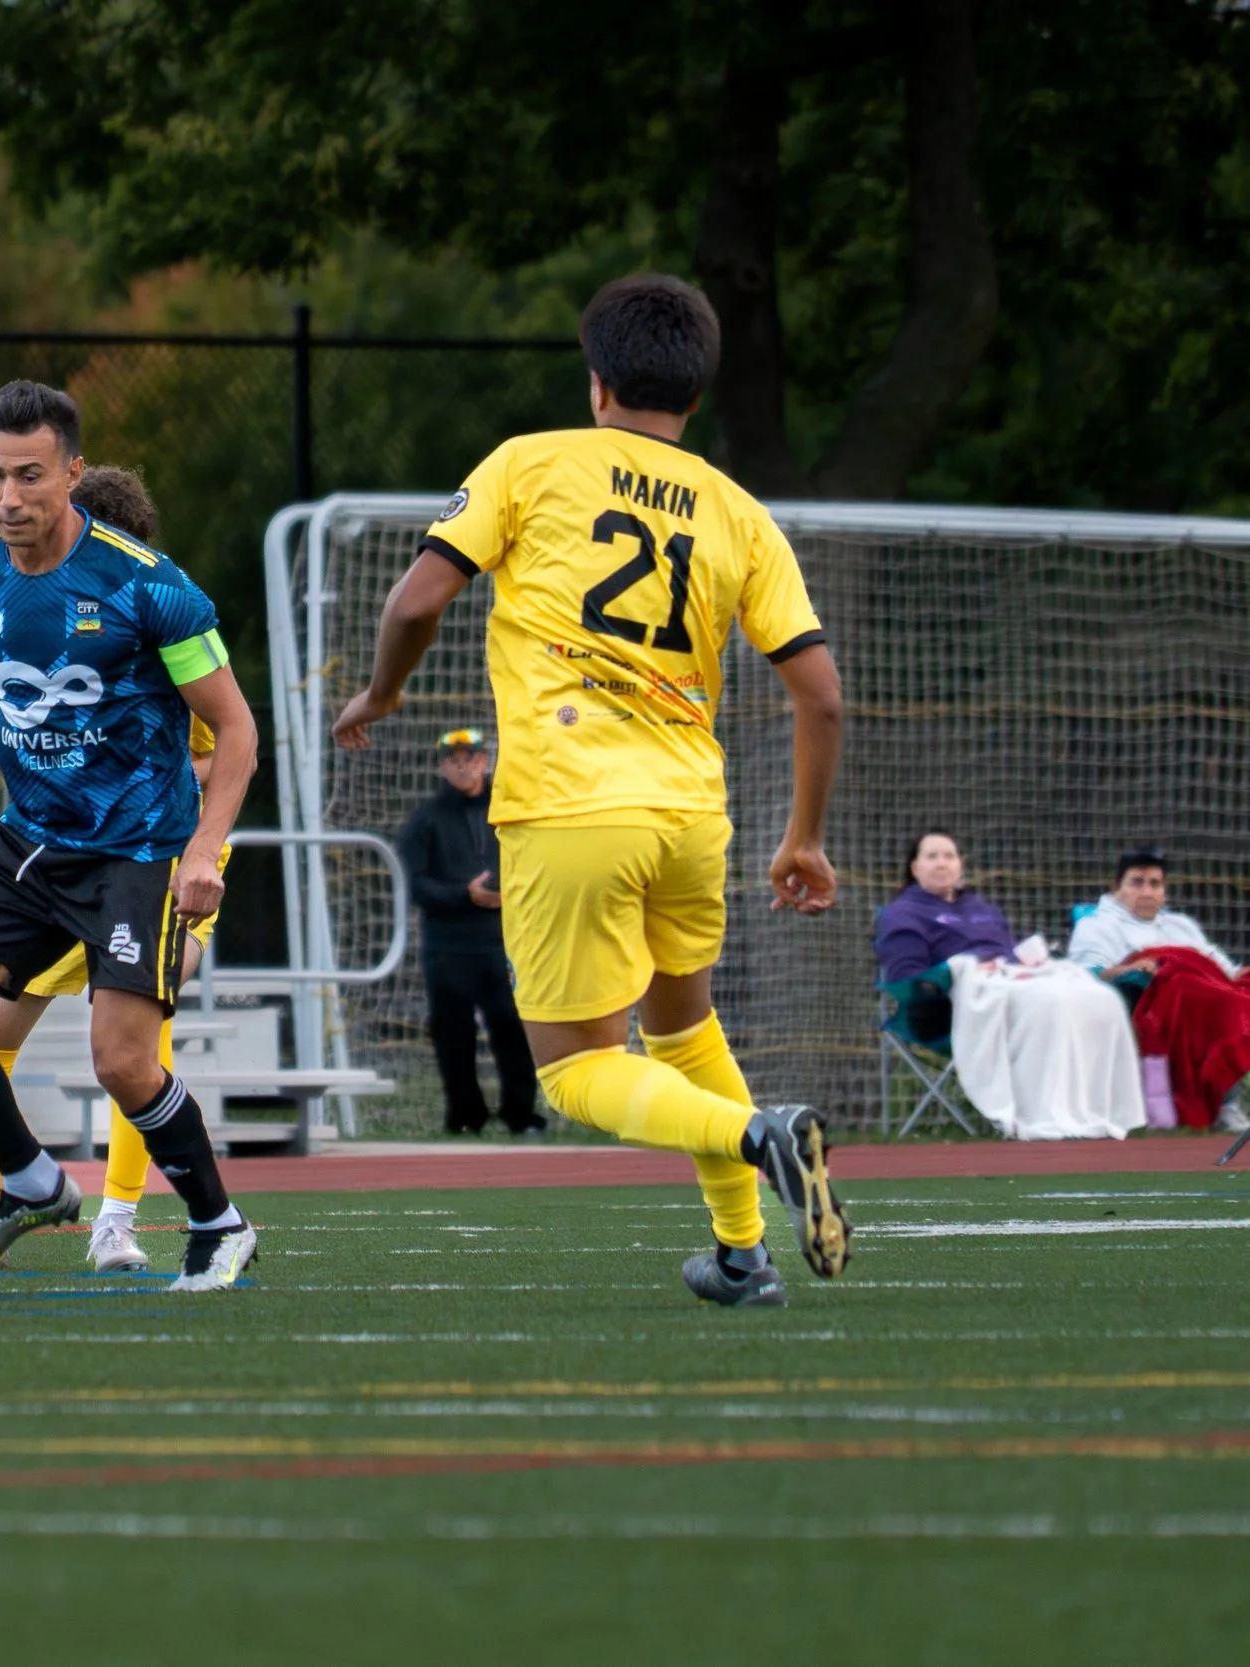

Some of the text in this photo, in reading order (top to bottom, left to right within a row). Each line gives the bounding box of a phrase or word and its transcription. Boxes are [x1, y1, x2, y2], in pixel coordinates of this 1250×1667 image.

[611, 465, 698, 521] MAKIN
[581, 509, 695, 654] 21
[1, 726, 109, 750] UNIVERSAL
